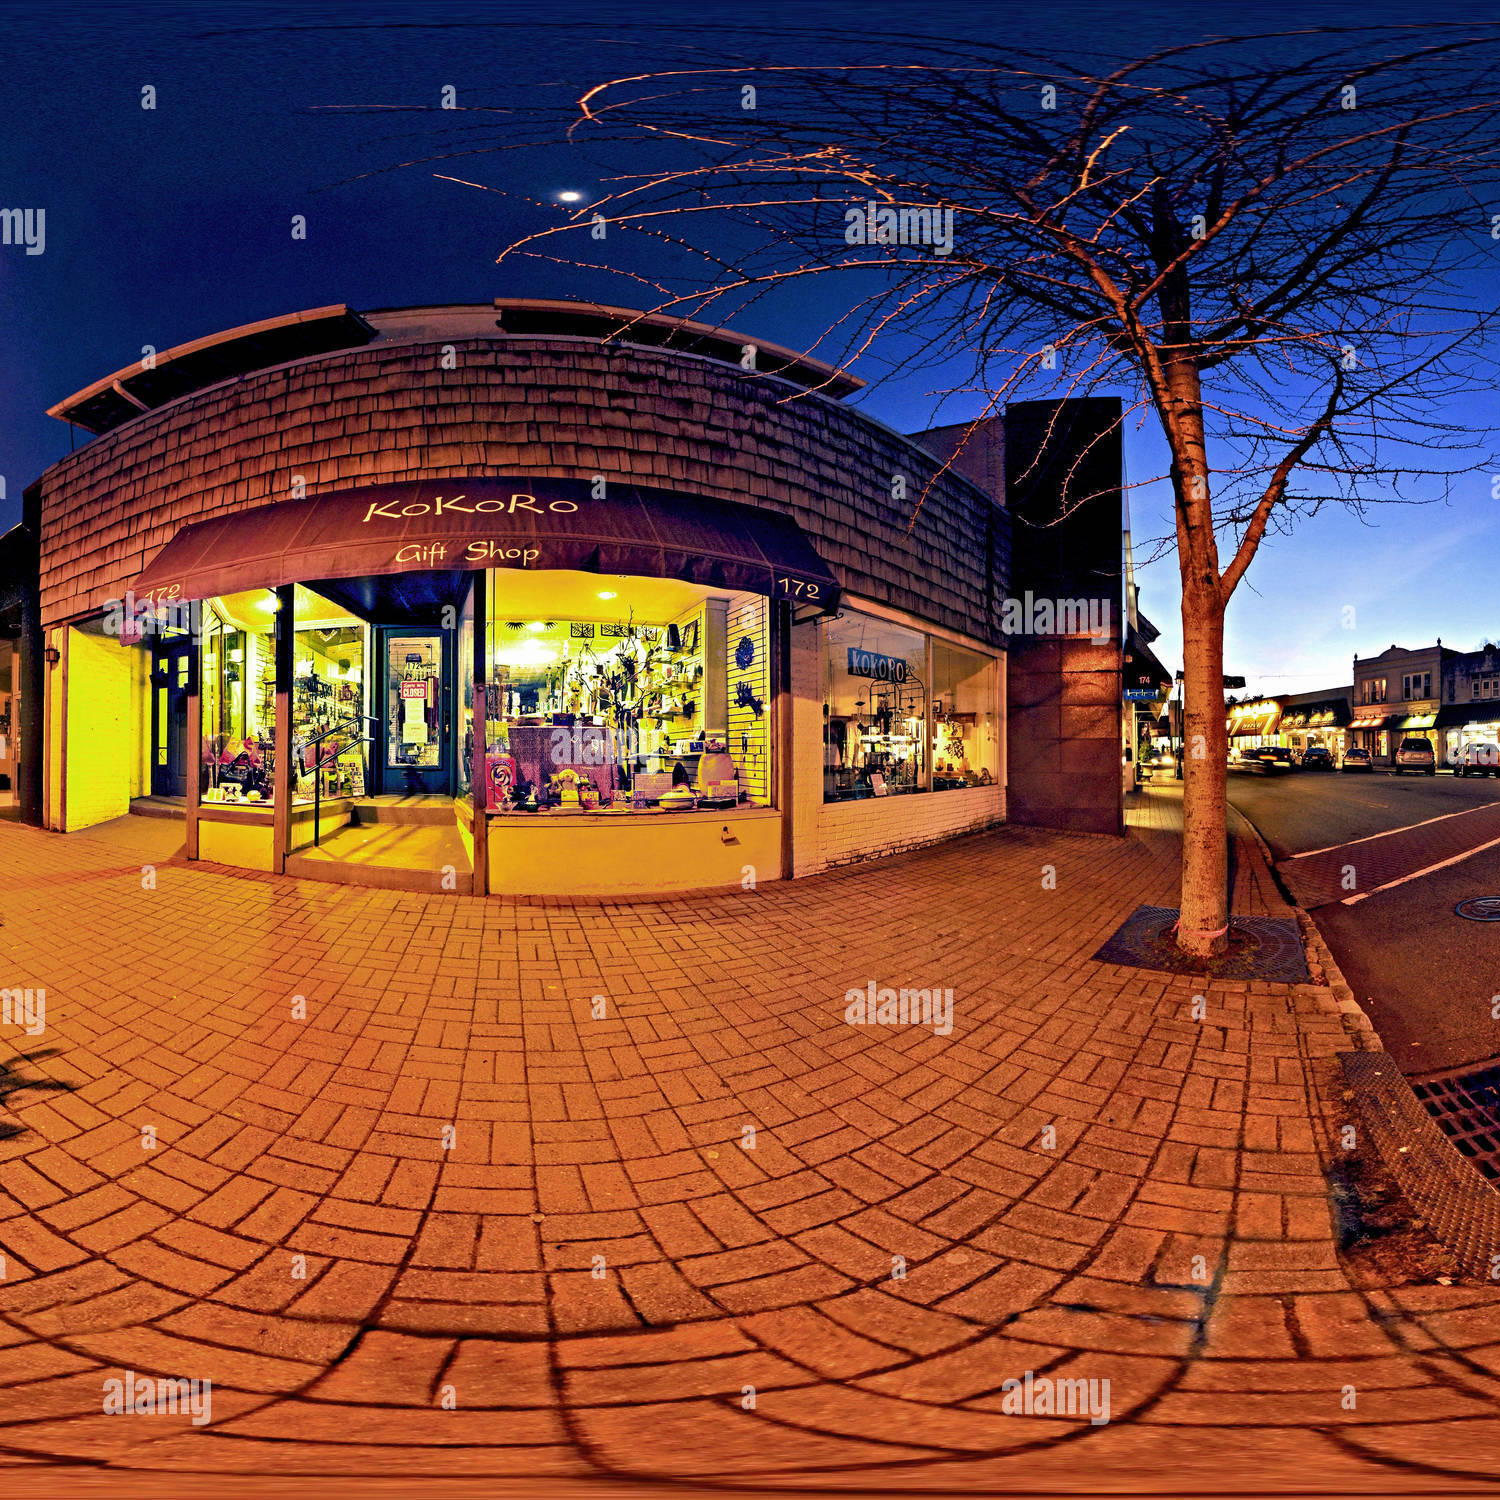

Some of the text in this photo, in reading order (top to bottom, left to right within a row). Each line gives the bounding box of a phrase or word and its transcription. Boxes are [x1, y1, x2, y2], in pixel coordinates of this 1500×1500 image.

[395, 540, 539, 567] Gift Shop
[145, 584, 180, 603] 172
[778, 578, 820, 599] 172
[852, 649, 904, 682] KOKORO
